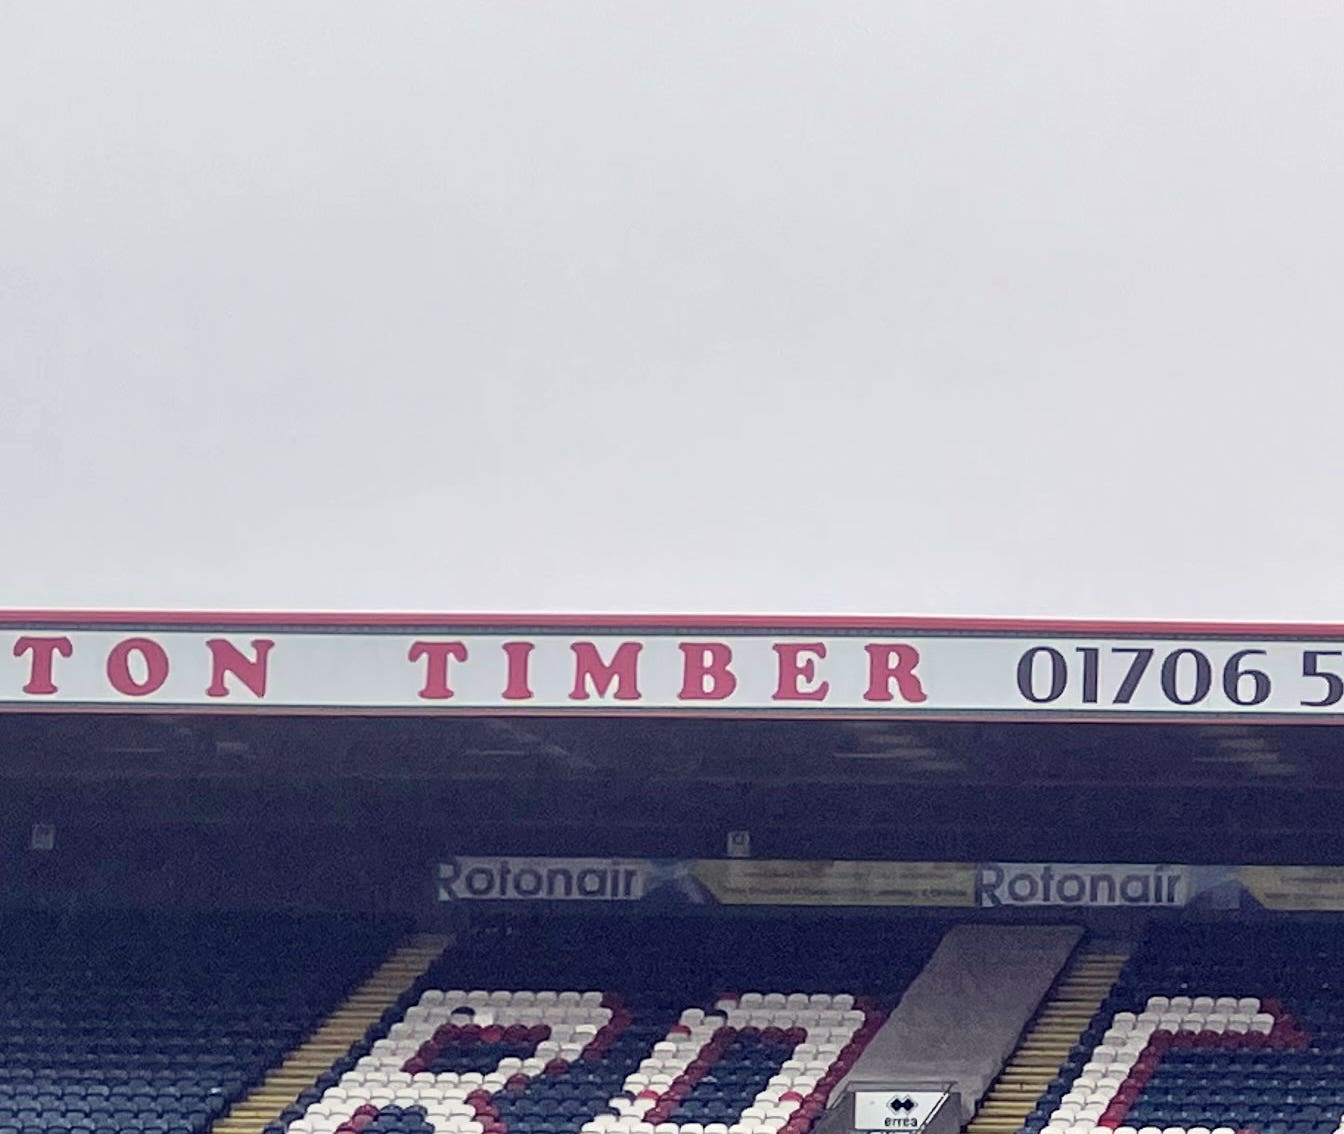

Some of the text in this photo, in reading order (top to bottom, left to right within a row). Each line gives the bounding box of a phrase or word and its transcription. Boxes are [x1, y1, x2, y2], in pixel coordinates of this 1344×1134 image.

[13, 636, 929, 703] TON TIMBER
[1016, 646, 1273, 708] 01706
[434, 859, 638, 899] Rotonair
[975, 864, 1180, 907] Rotonair
